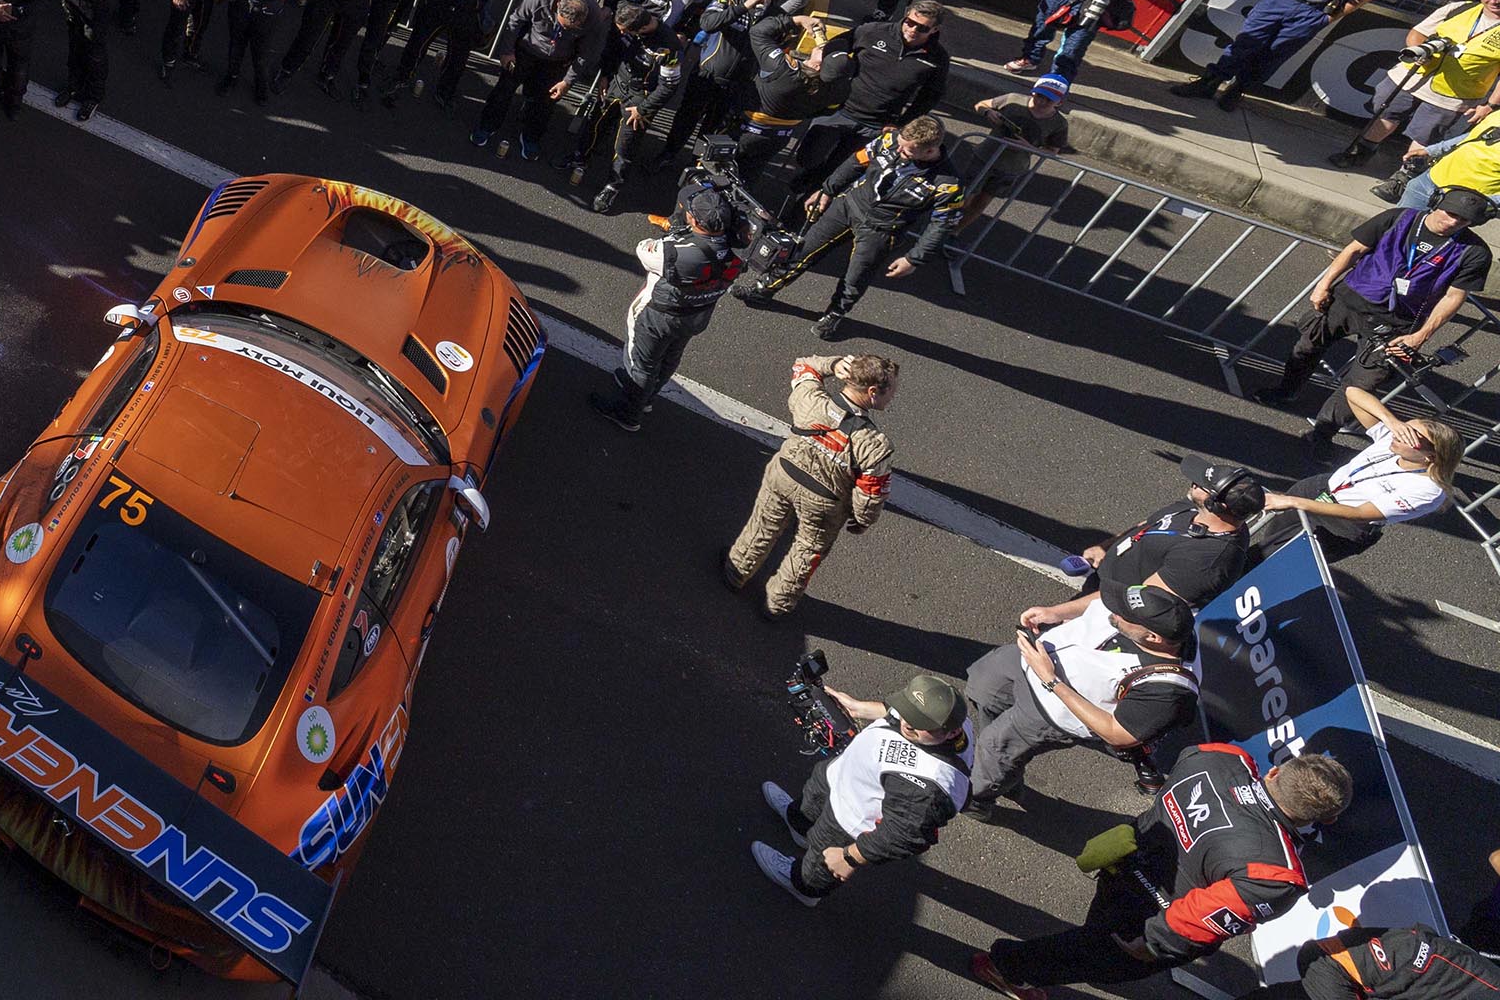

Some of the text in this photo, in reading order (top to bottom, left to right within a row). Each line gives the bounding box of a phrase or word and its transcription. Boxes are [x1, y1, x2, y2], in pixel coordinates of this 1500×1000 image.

[180, 327, 219, 344] 75
[237, 344, 377, 427] LIQUI MOLY
[112, 391, 144, 438] LUCA STOLZ
[56, 453, 102, 519] JULES GOUNON
[98, 474, 155, 528] 75
[350, 526, 377, 584] LUCA STOLZ
[313, 601, 348, 687] JULES GOUNON
[307, 710, 318, 722] bp
[899, 742, 909, 766] MOLY
[1166, 798, 1181, 827] VOLANTE
